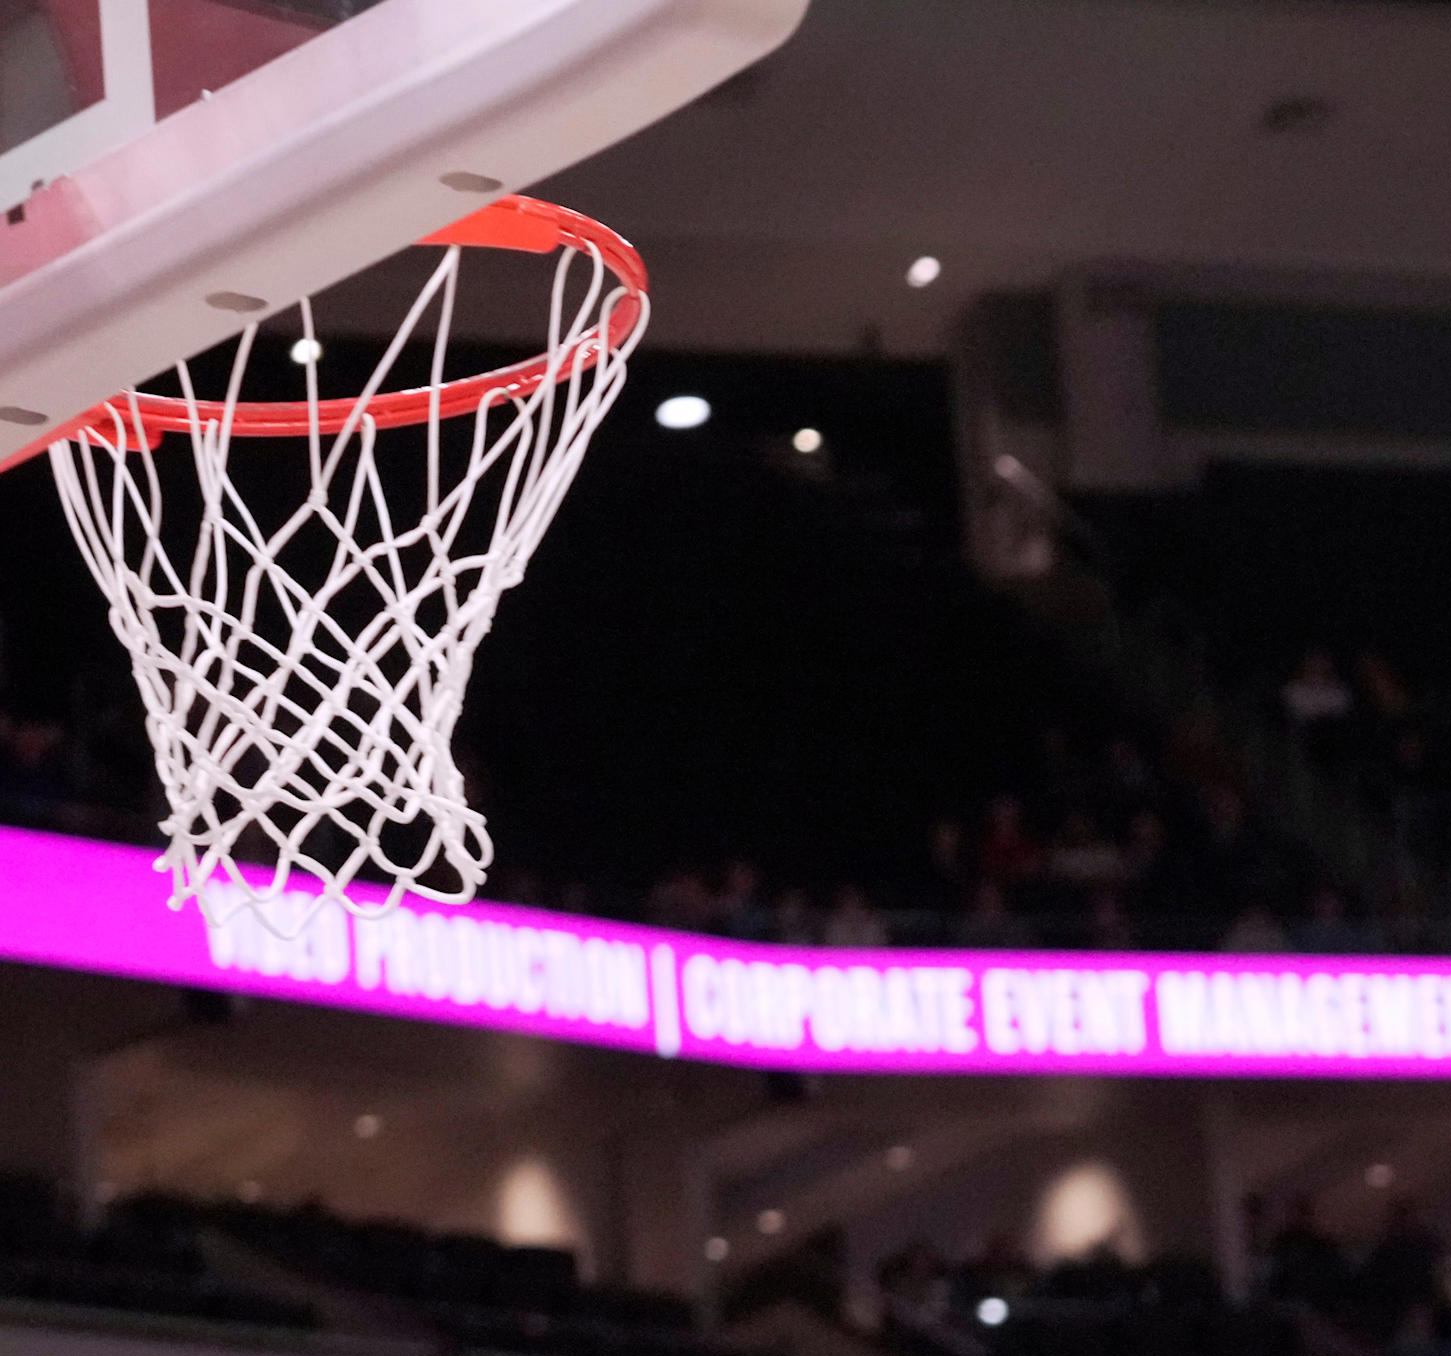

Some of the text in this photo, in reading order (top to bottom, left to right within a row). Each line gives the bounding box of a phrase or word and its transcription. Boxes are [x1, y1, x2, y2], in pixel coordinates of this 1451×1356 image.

[354, 900, 648, 1030] PRODUCTION
[683, 953, 979, 1054] CORPORATE
[981, 966, 1150, 1056] EVENT
